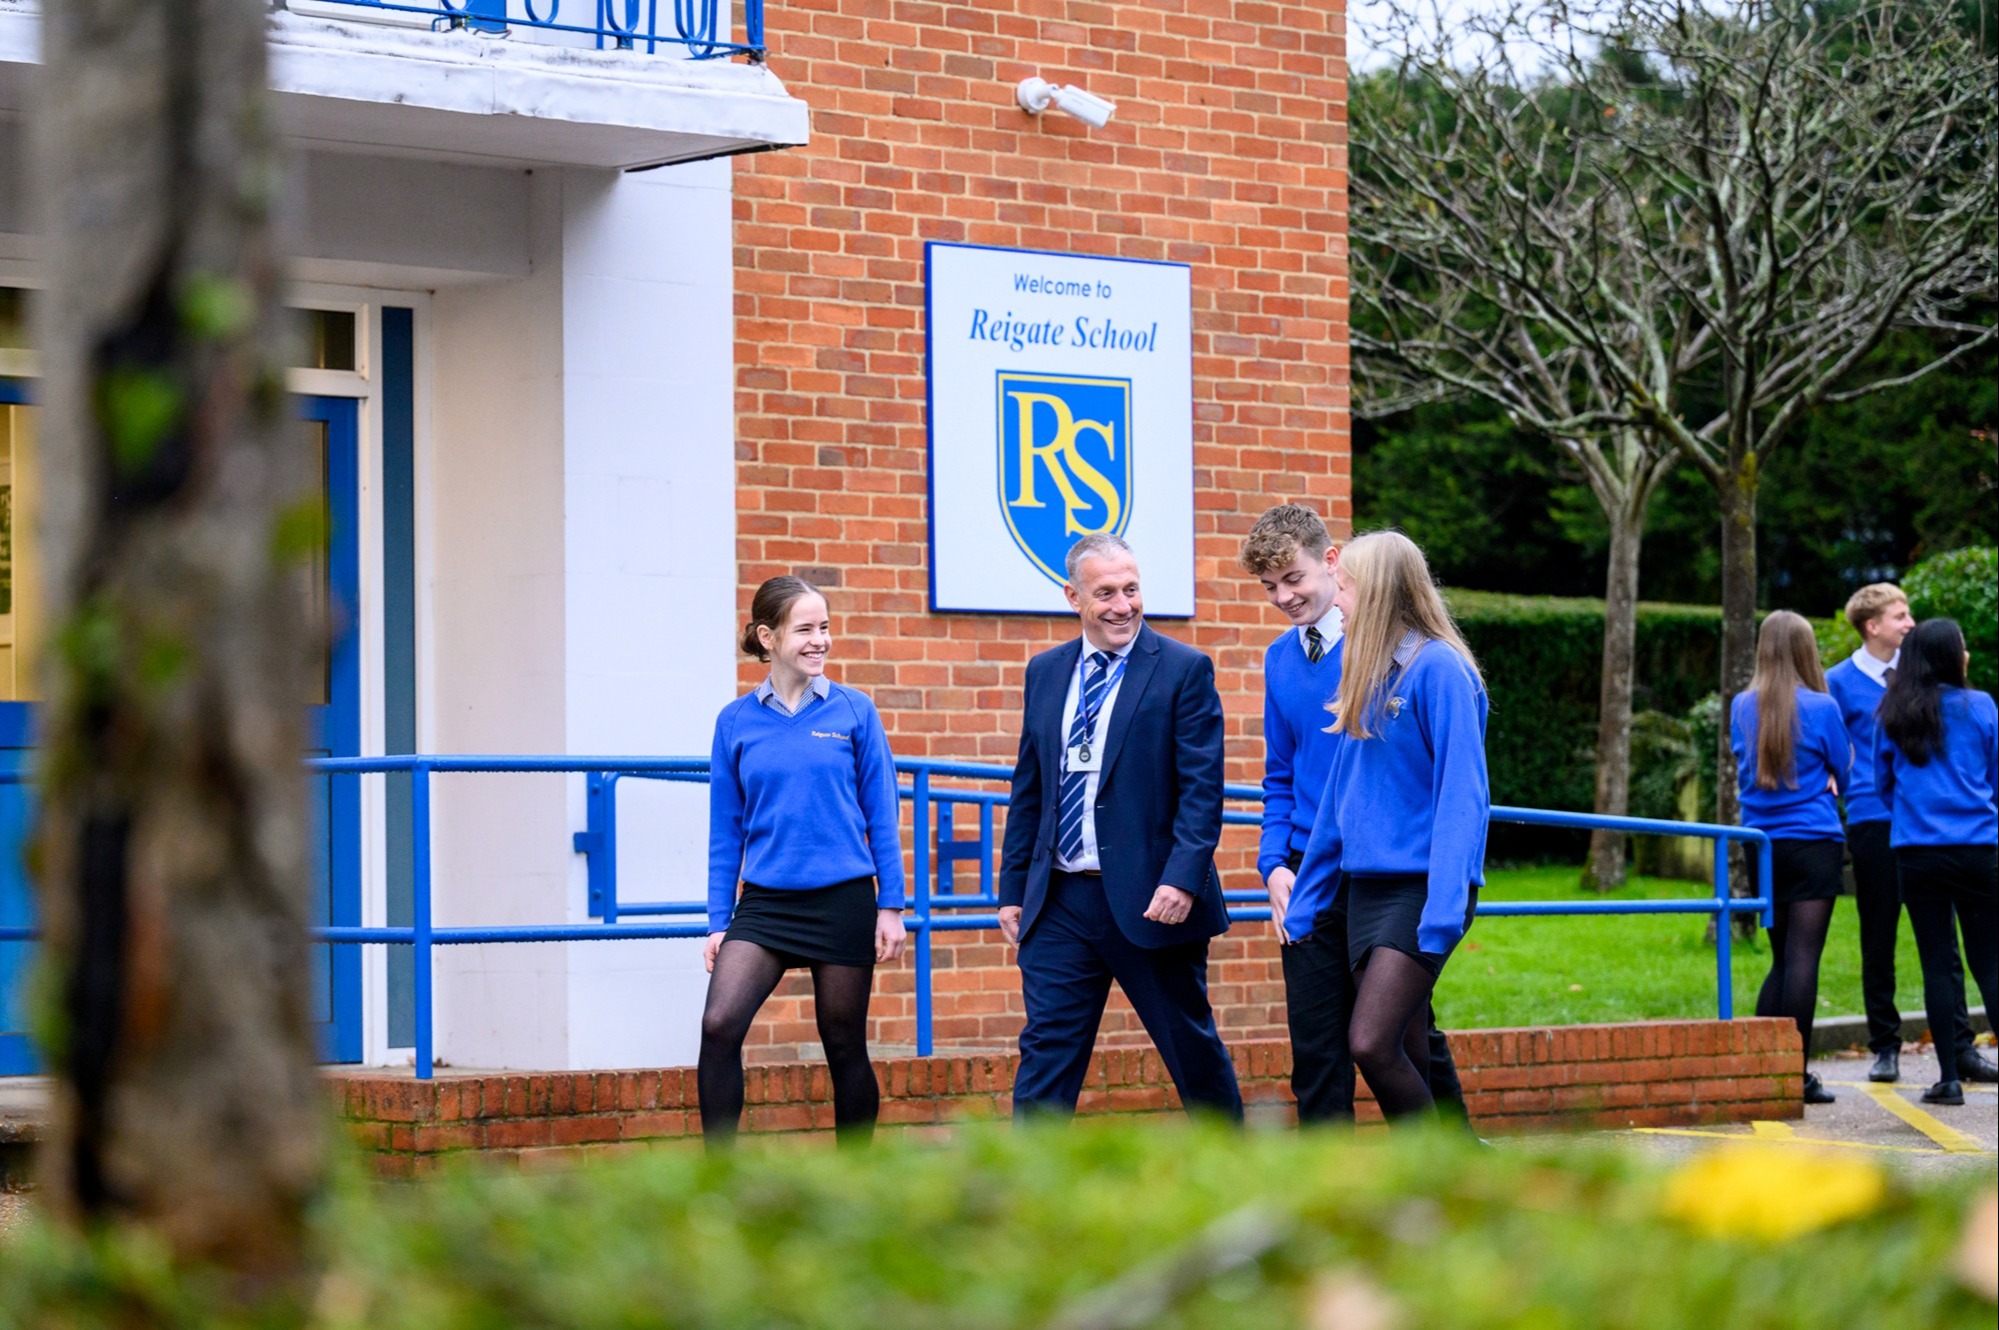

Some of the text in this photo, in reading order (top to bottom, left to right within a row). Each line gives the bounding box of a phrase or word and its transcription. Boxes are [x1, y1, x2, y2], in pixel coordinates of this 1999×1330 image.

[1014, 274, 1112, 299] Welcome to
[968, 308, 1157, 352] Reigate School
[1007, 391, 1120, 537] RS
